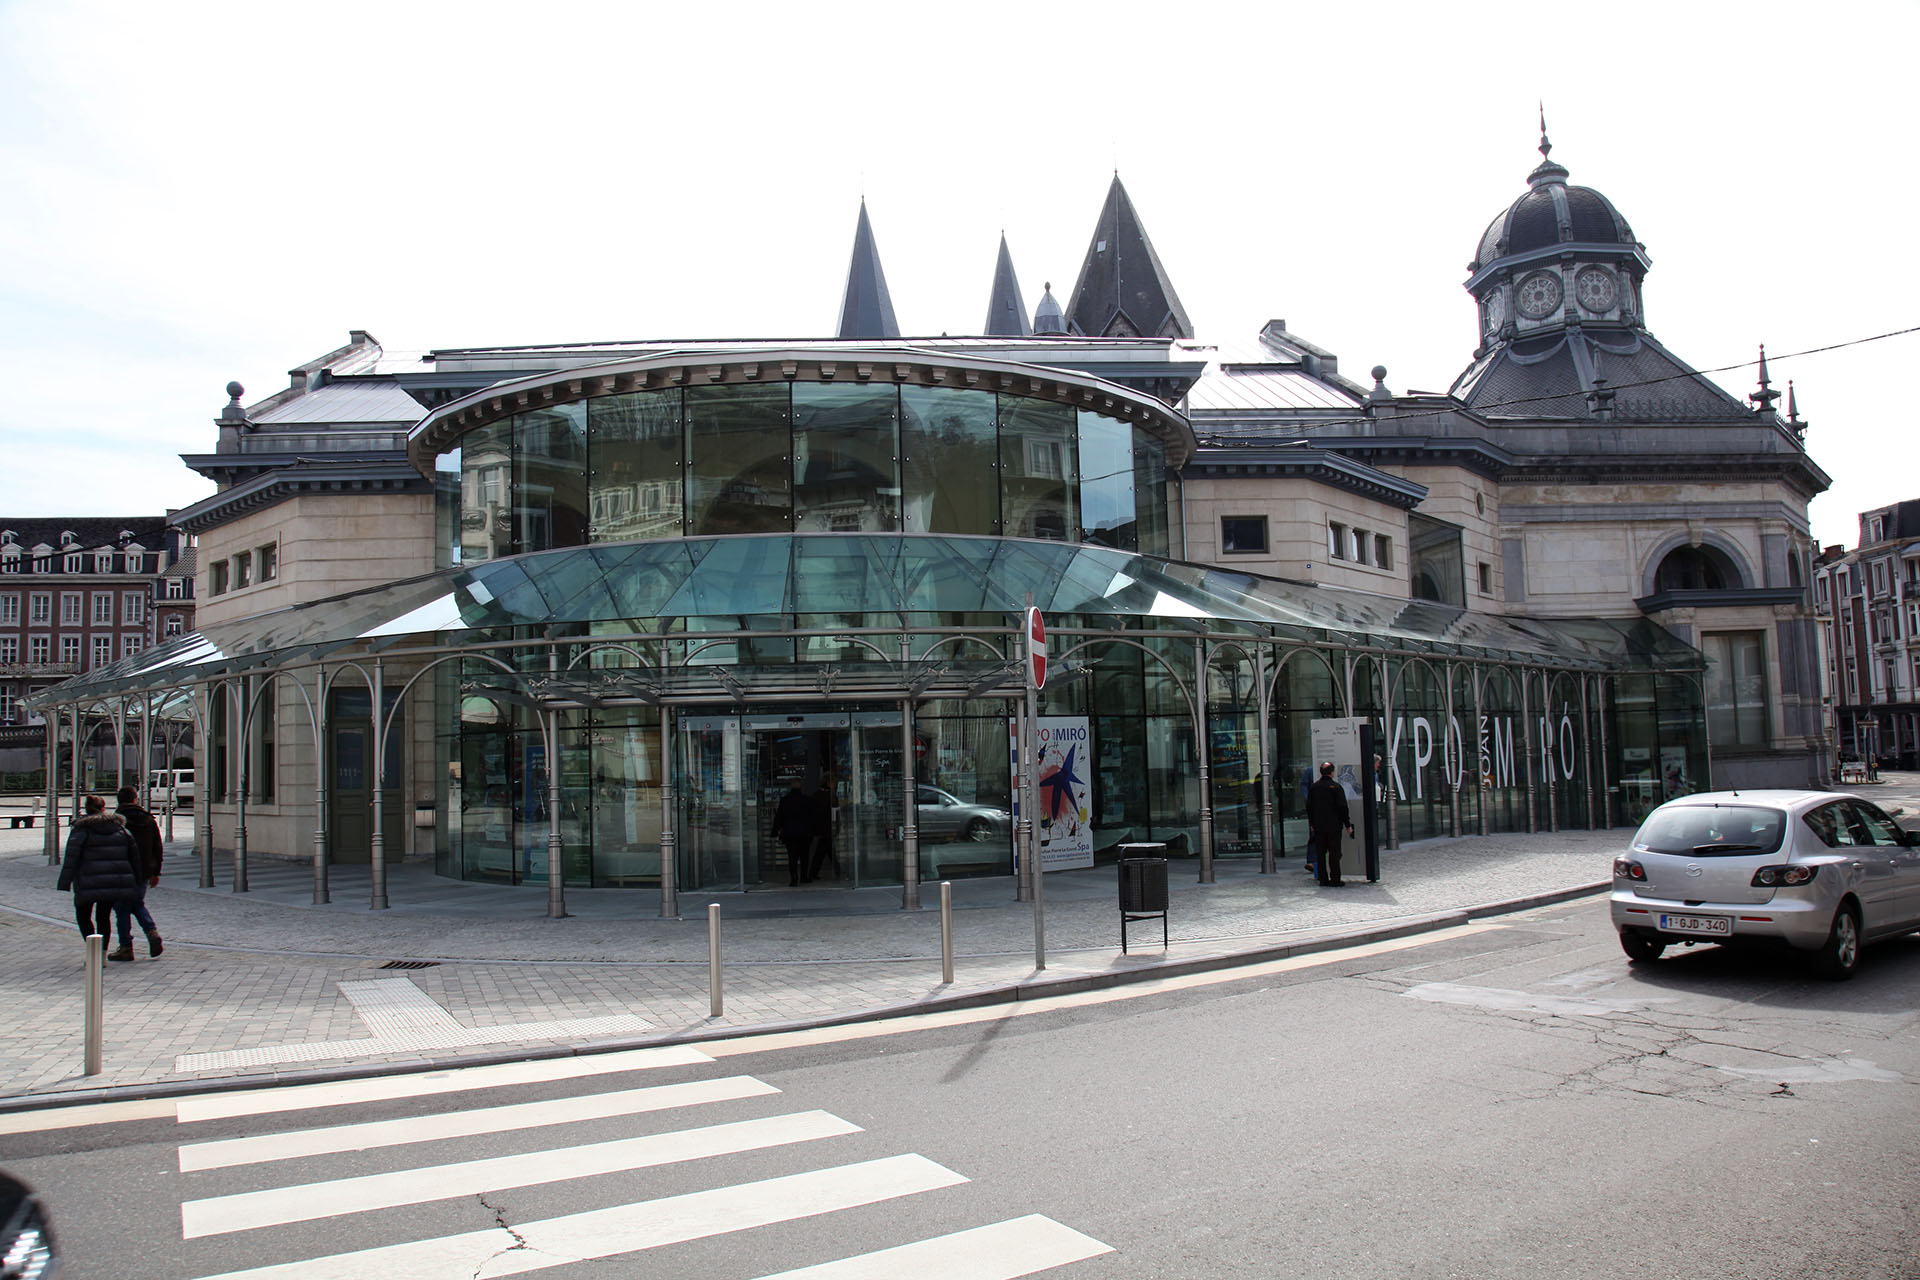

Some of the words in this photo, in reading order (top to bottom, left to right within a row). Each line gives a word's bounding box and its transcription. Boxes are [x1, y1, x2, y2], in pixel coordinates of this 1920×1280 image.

[1055, 725, 1087, 741] MIRÓ
[1494, 701, 1575, 789] MRÓ
[1077, 842, 1090, 852] Spa
